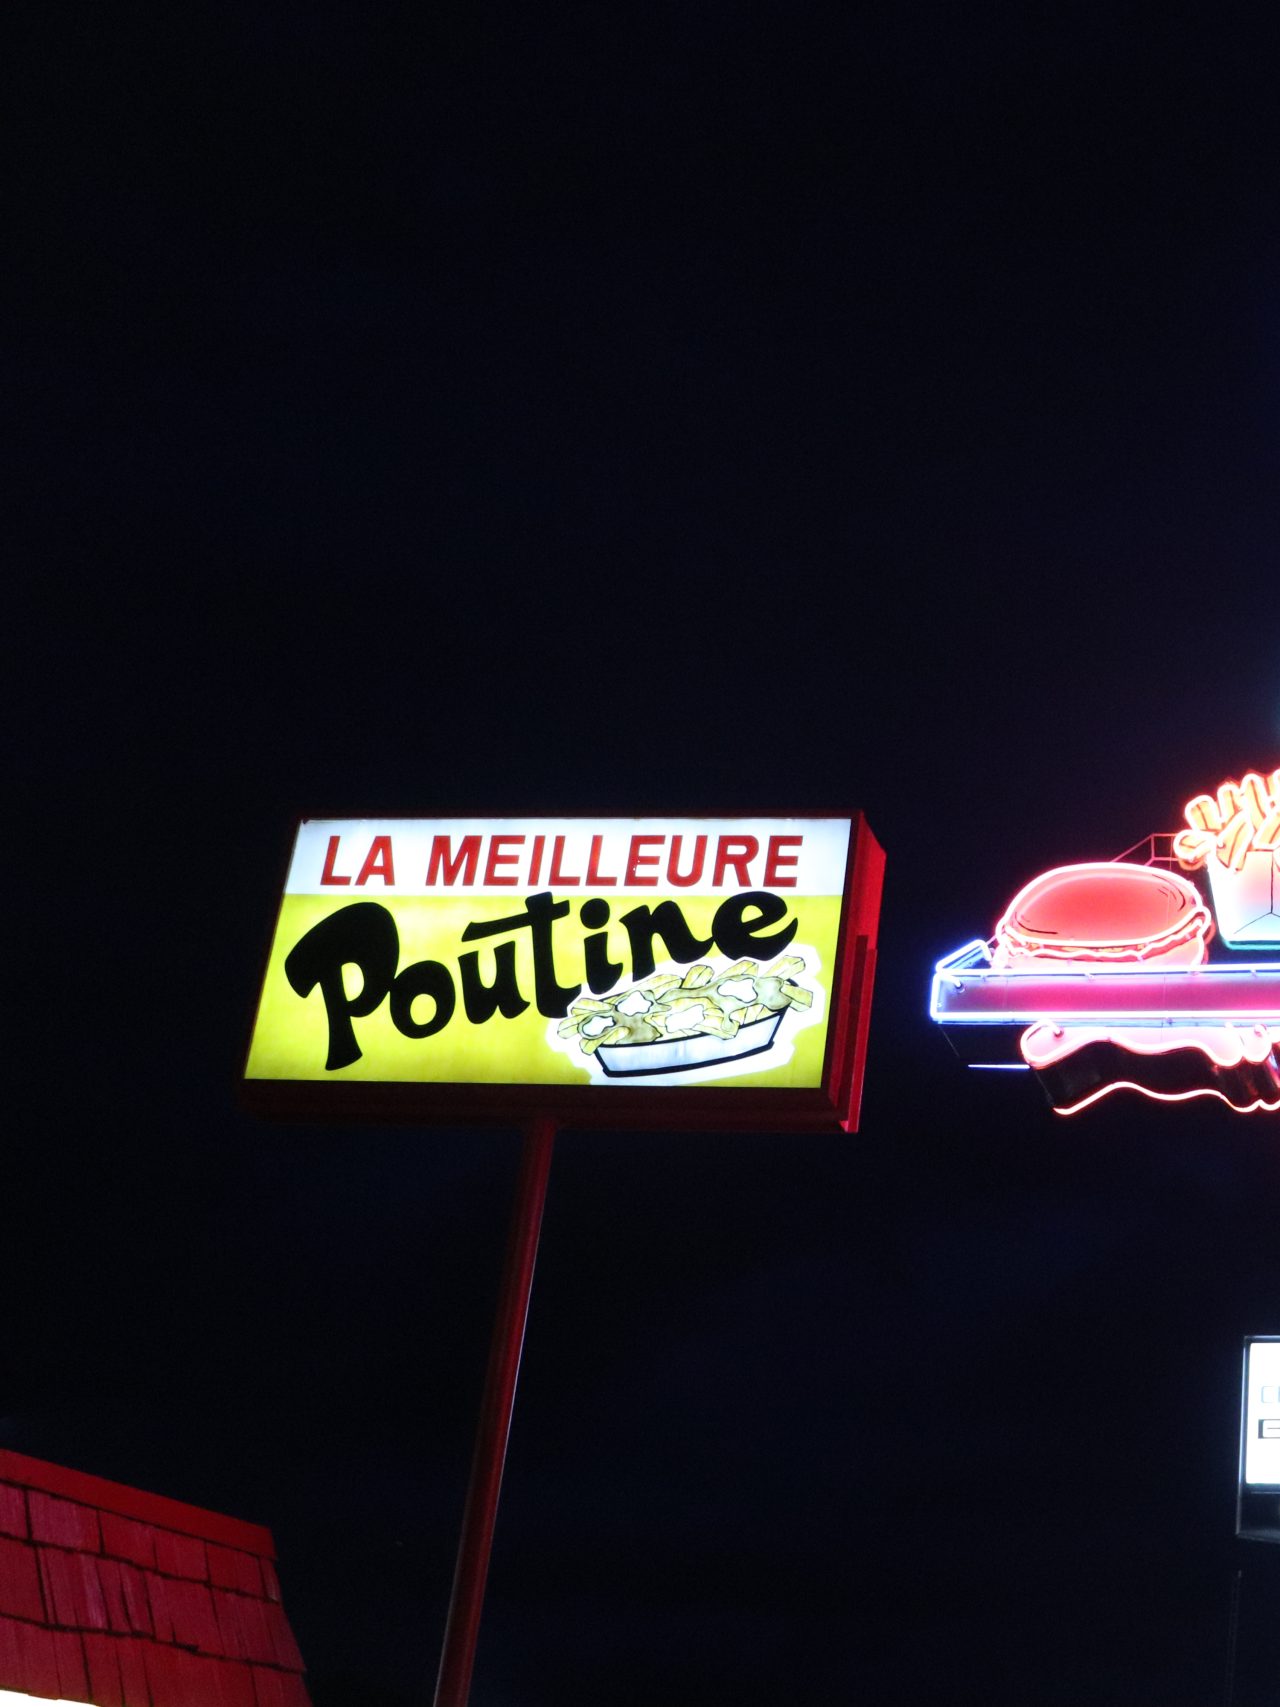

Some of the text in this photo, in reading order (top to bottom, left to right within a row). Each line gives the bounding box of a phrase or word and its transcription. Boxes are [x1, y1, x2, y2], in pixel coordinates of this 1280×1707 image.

[320, 834, 804, 888] LA MEILLEURE
[284, 890, 798, 1072] Poutine
